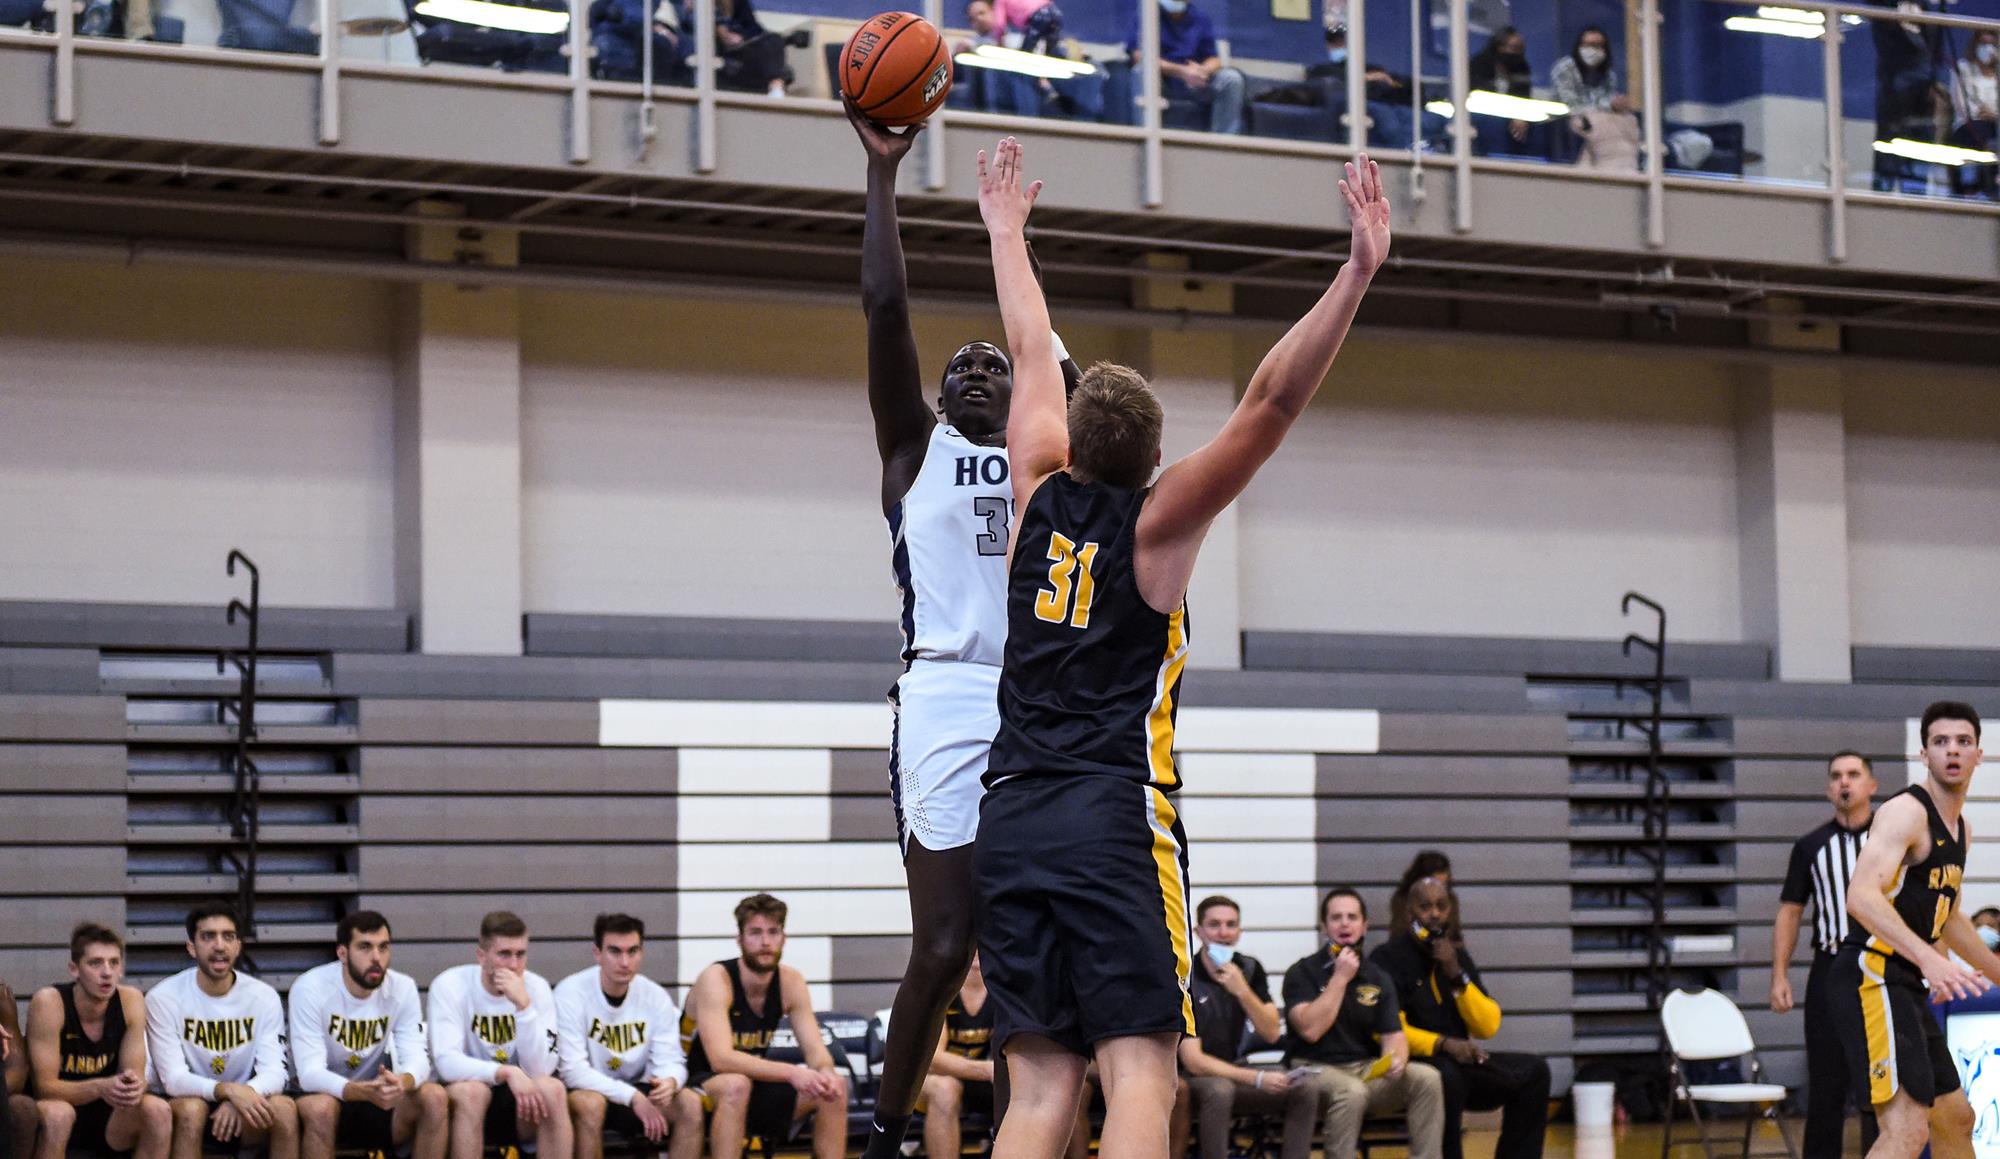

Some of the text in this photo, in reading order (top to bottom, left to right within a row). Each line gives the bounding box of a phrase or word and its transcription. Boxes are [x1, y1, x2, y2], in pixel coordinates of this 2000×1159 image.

[851, 32, 881, 71] ROCK
[924, 69, 948, 103] MAC
[974, 497, 1015, 556] 3
[1034, 531, 1099, 629] 31
[183, 1017, 255, 1053] FAMILY
[328, 1014, 389, 1051] FAMILY
[589, 1017, 646, 1053] FAMILY
